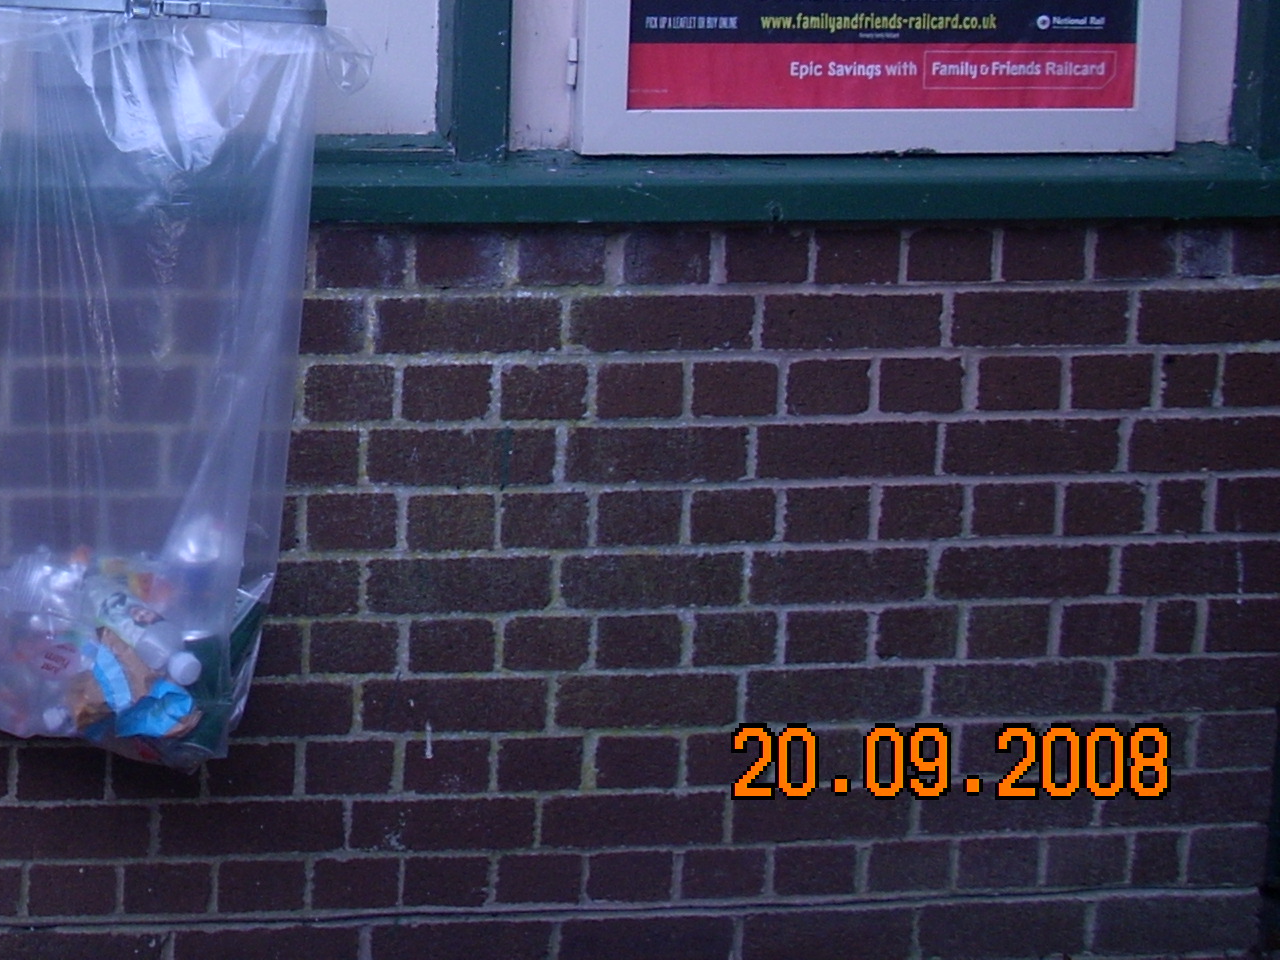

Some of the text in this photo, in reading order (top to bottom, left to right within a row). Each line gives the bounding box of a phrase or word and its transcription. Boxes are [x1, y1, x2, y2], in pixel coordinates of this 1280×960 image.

[760, 12, 997, 33] www.familyandfriends-railcard.co.uk
[1052, 16, 1105, 25] National Rail
[790, 61, 917, 79] Epic Savings with
[932, 62, 977, 78] Family
[991, 62, 1040, 77] Friends
[1045, 62, 1105, 77] Railcard
